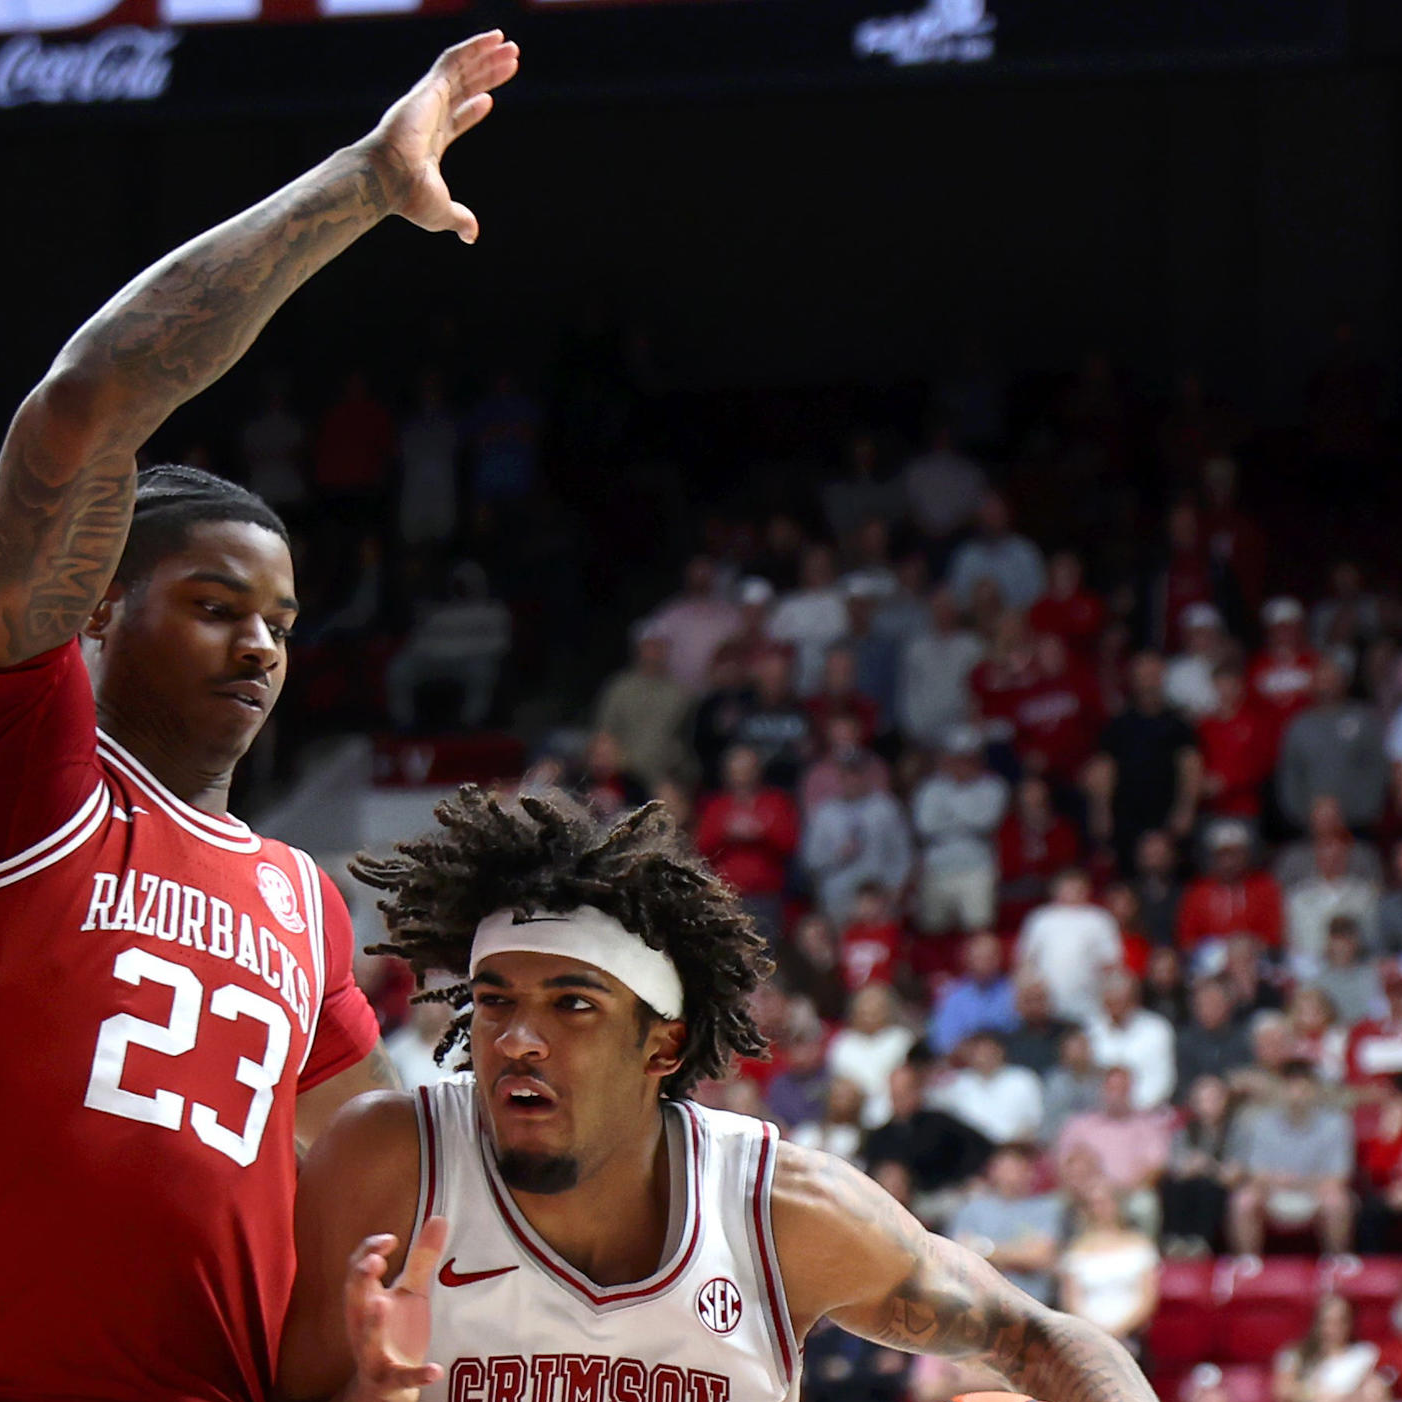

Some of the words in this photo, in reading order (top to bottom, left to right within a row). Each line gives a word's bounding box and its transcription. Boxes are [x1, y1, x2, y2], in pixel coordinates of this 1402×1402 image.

[80, 868, 312, 1035] RAZORBACKS
[83, 946, 292, 1168] 23
[699, 1280, 741, 1333] SEC
